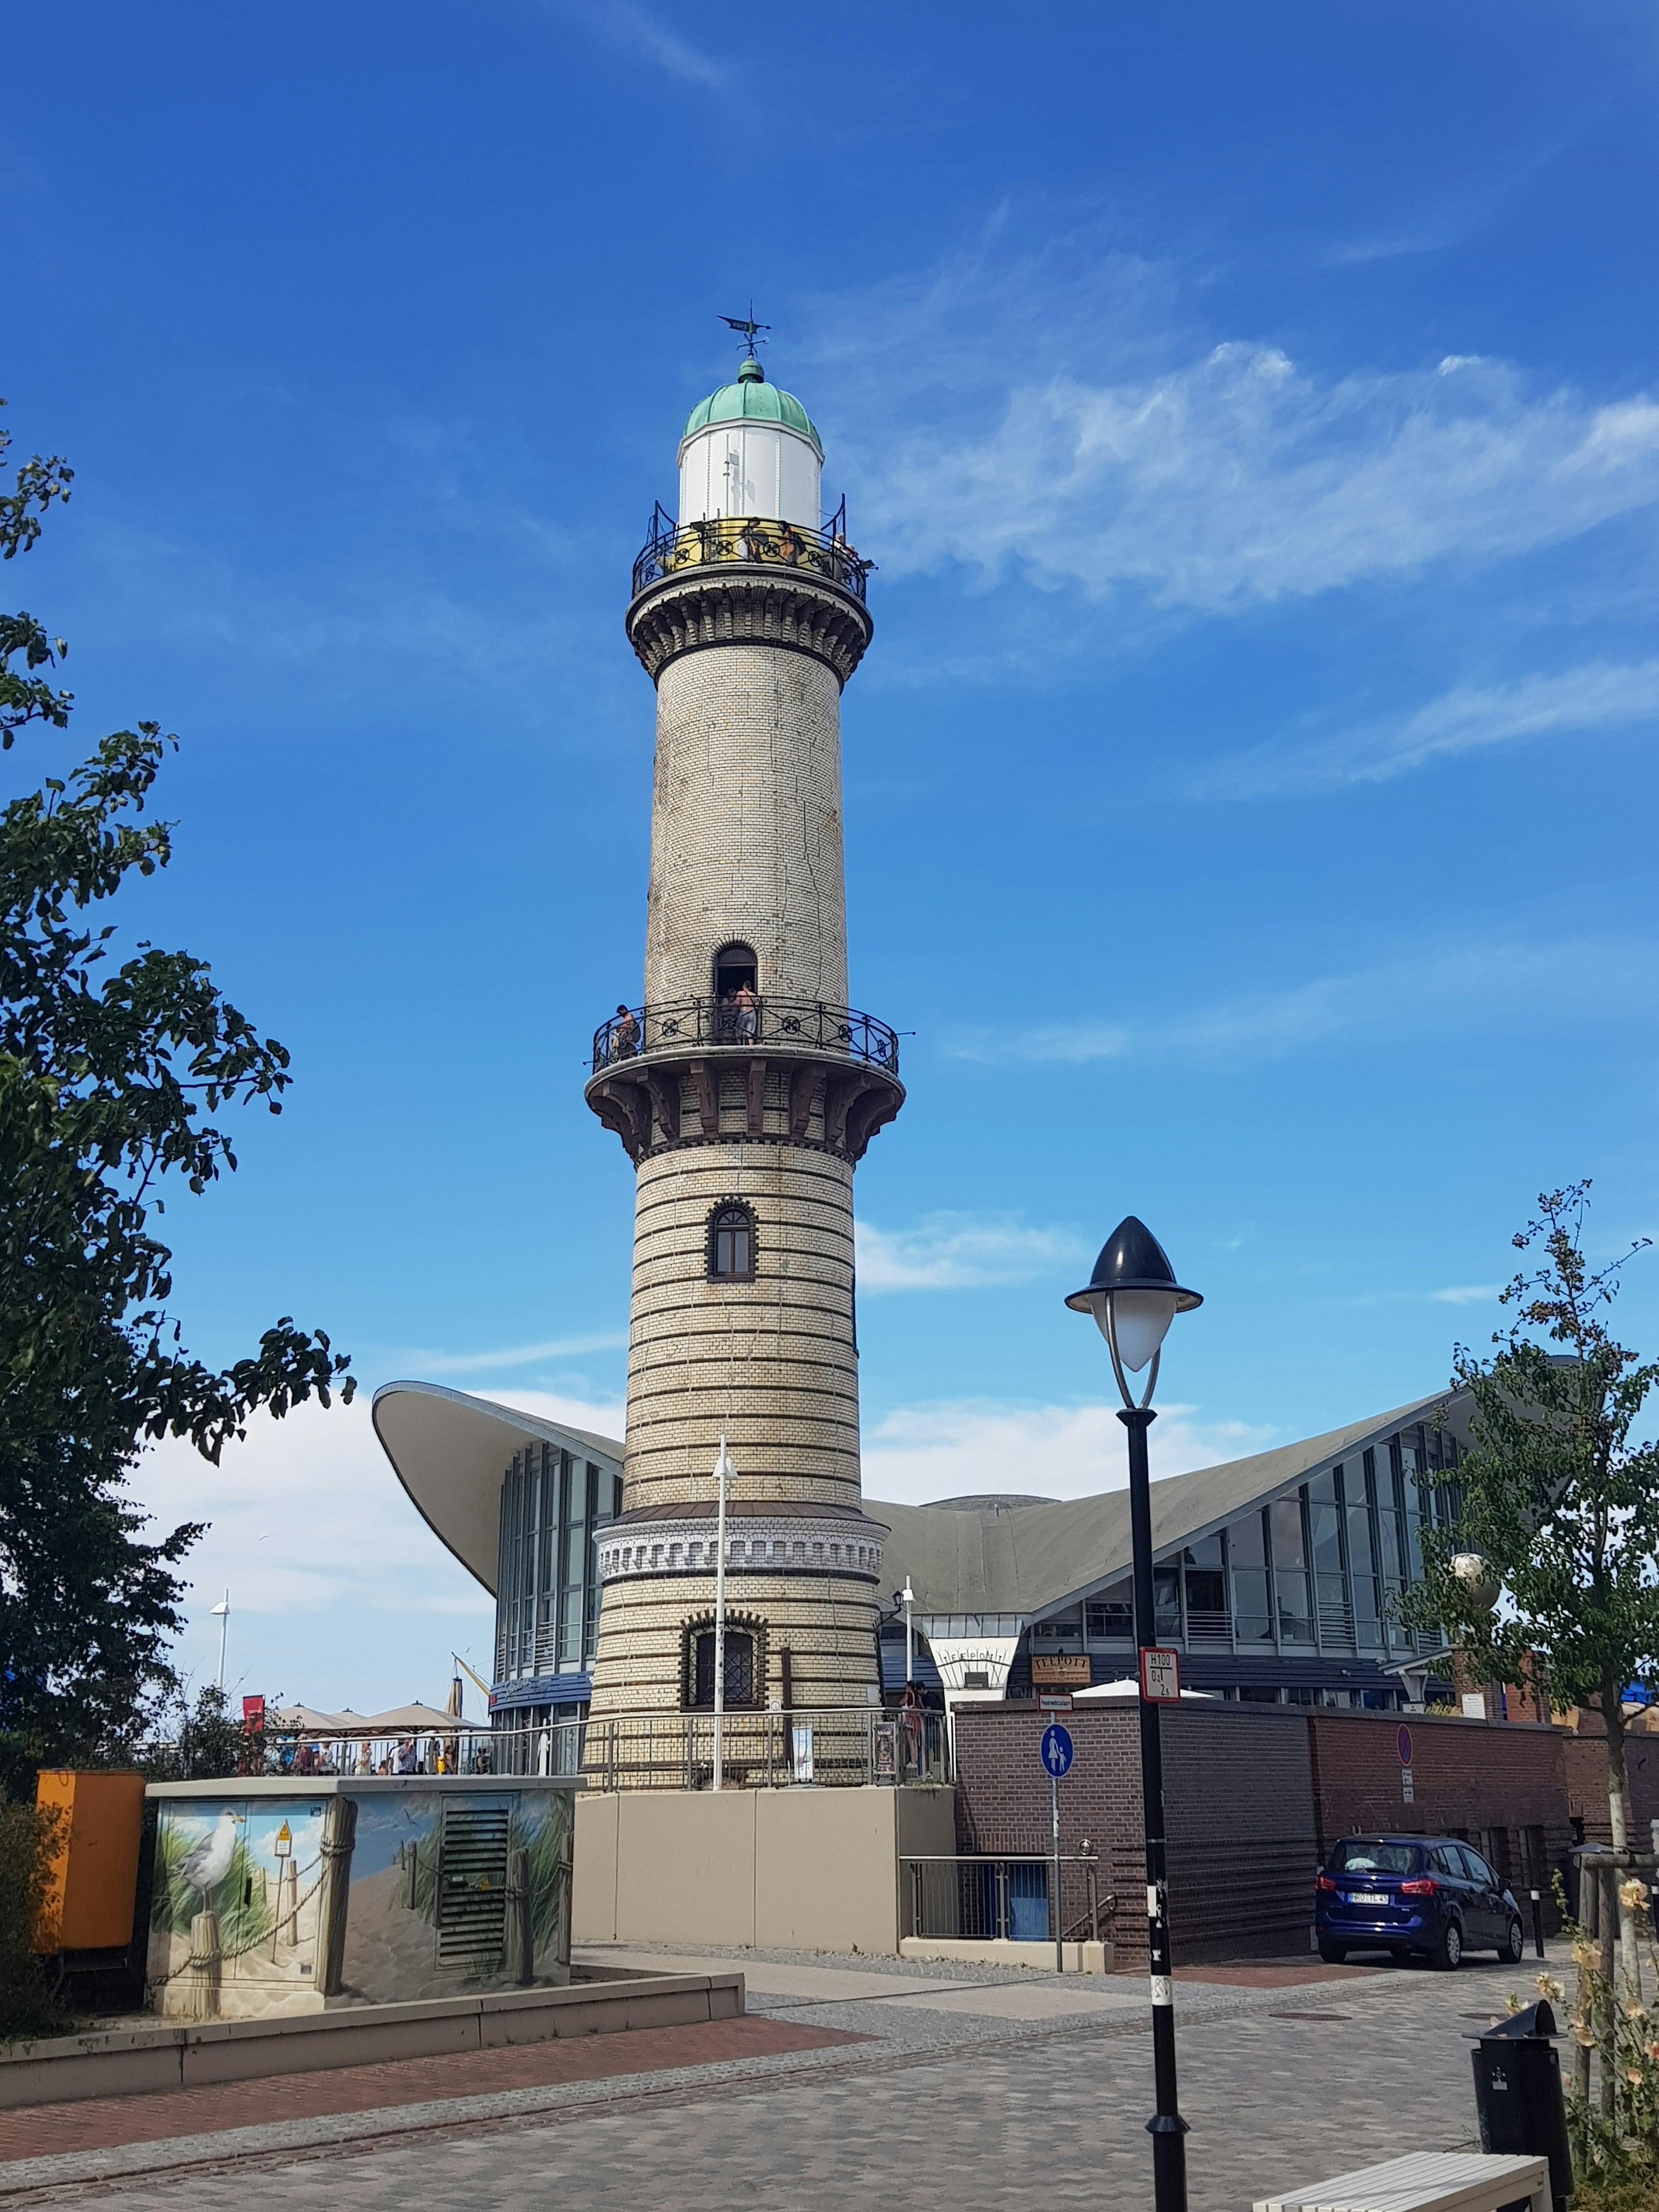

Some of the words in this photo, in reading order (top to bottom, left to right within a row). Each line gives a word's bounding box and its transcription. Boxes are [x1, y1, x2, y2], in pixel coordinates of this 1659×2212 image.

[944, 1653, 1002, 1663] TEEPOTT
[1036, 1657, 1087, 1668] TEEPOTT
[1151, 1654, 1170, 1666] H100
